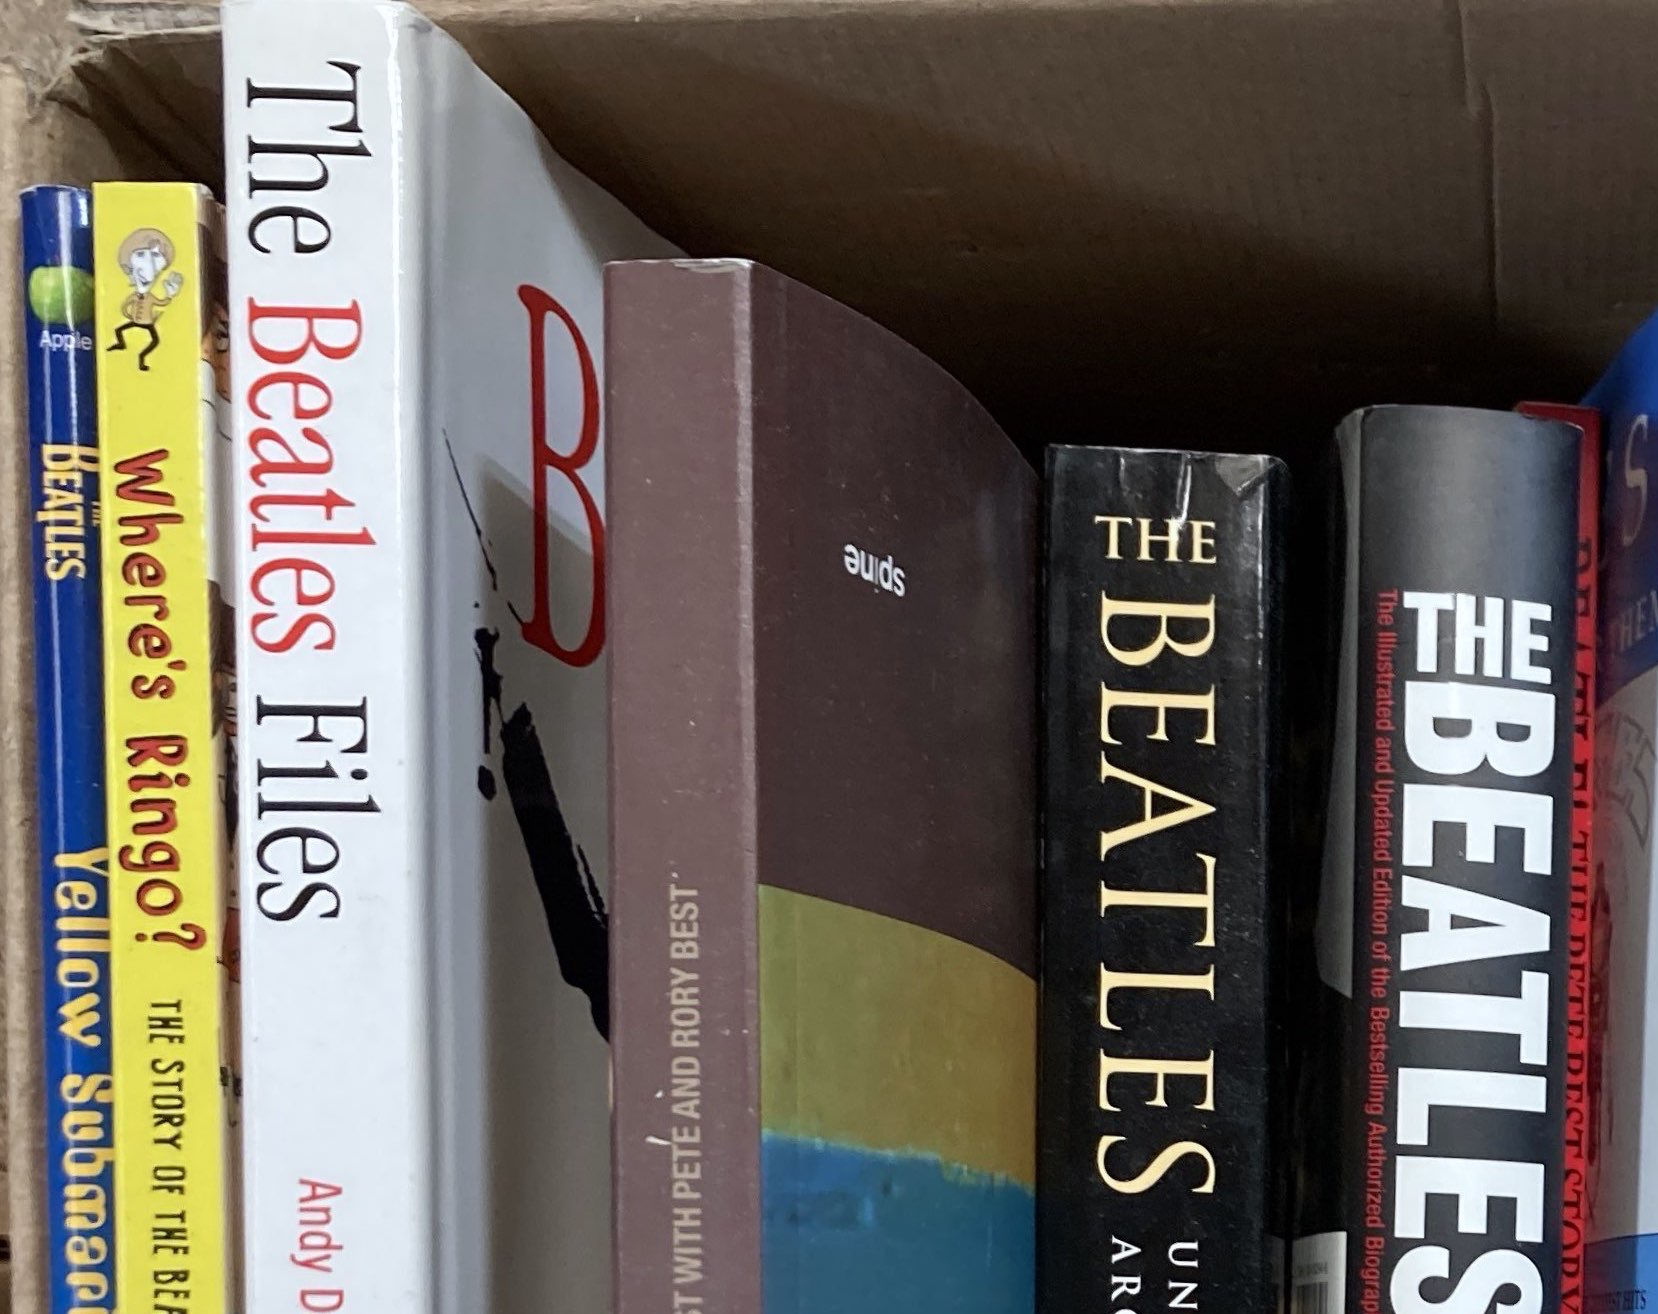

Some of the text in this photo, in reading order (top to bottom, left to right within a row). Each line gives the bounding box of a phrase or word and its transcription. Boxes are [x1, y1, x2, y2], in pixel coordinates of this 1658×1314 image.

[40, 330, 92, 351] Apple
[37, 444, 100, 581] BEATLES
[247, 61, 381, 921] The Beatles Files
[844, 545, 905, 596] spine
[1095, 515, 1216, 563] THE
[1378, 589, 1398, 625] The
[1404, 592, 1551, 684] THE
[113, 449, 206, 950] Where's Ringo?
[1376, 632, 1398, 730] Illustrated
[1375, 737, 1395, 773] and
[1372, 780, 1395, 861] Updated
[670, 884, 698, 959] BEST
[1097, 591, 1216, 1193] BEATLES
[1373, 868, 1393, 934] Edition
[55, 844, 112, 1046] Yellow
[1371, 967, 1391, 997] the
[1373, 941, 1392, 961] of
[148, 1000, 184, 1043] THE
[670, 968, 700, 1047] RORY
[672, 1057, 700, 1119] AND
[1365, 1007, 1390, 1115] Bestselling
[151, 1059, 185, 1149] STORY
[152, 1166, 186, 1194] OF
[670, 1127, 701, 1199] PETE
[1367, 1122, 1387, 1227] Authorized
[152, 1211, 189, 1254] THE
[290, 1179, 343, 1272] Andy
[673, 1208, 703, 1283] WITH
